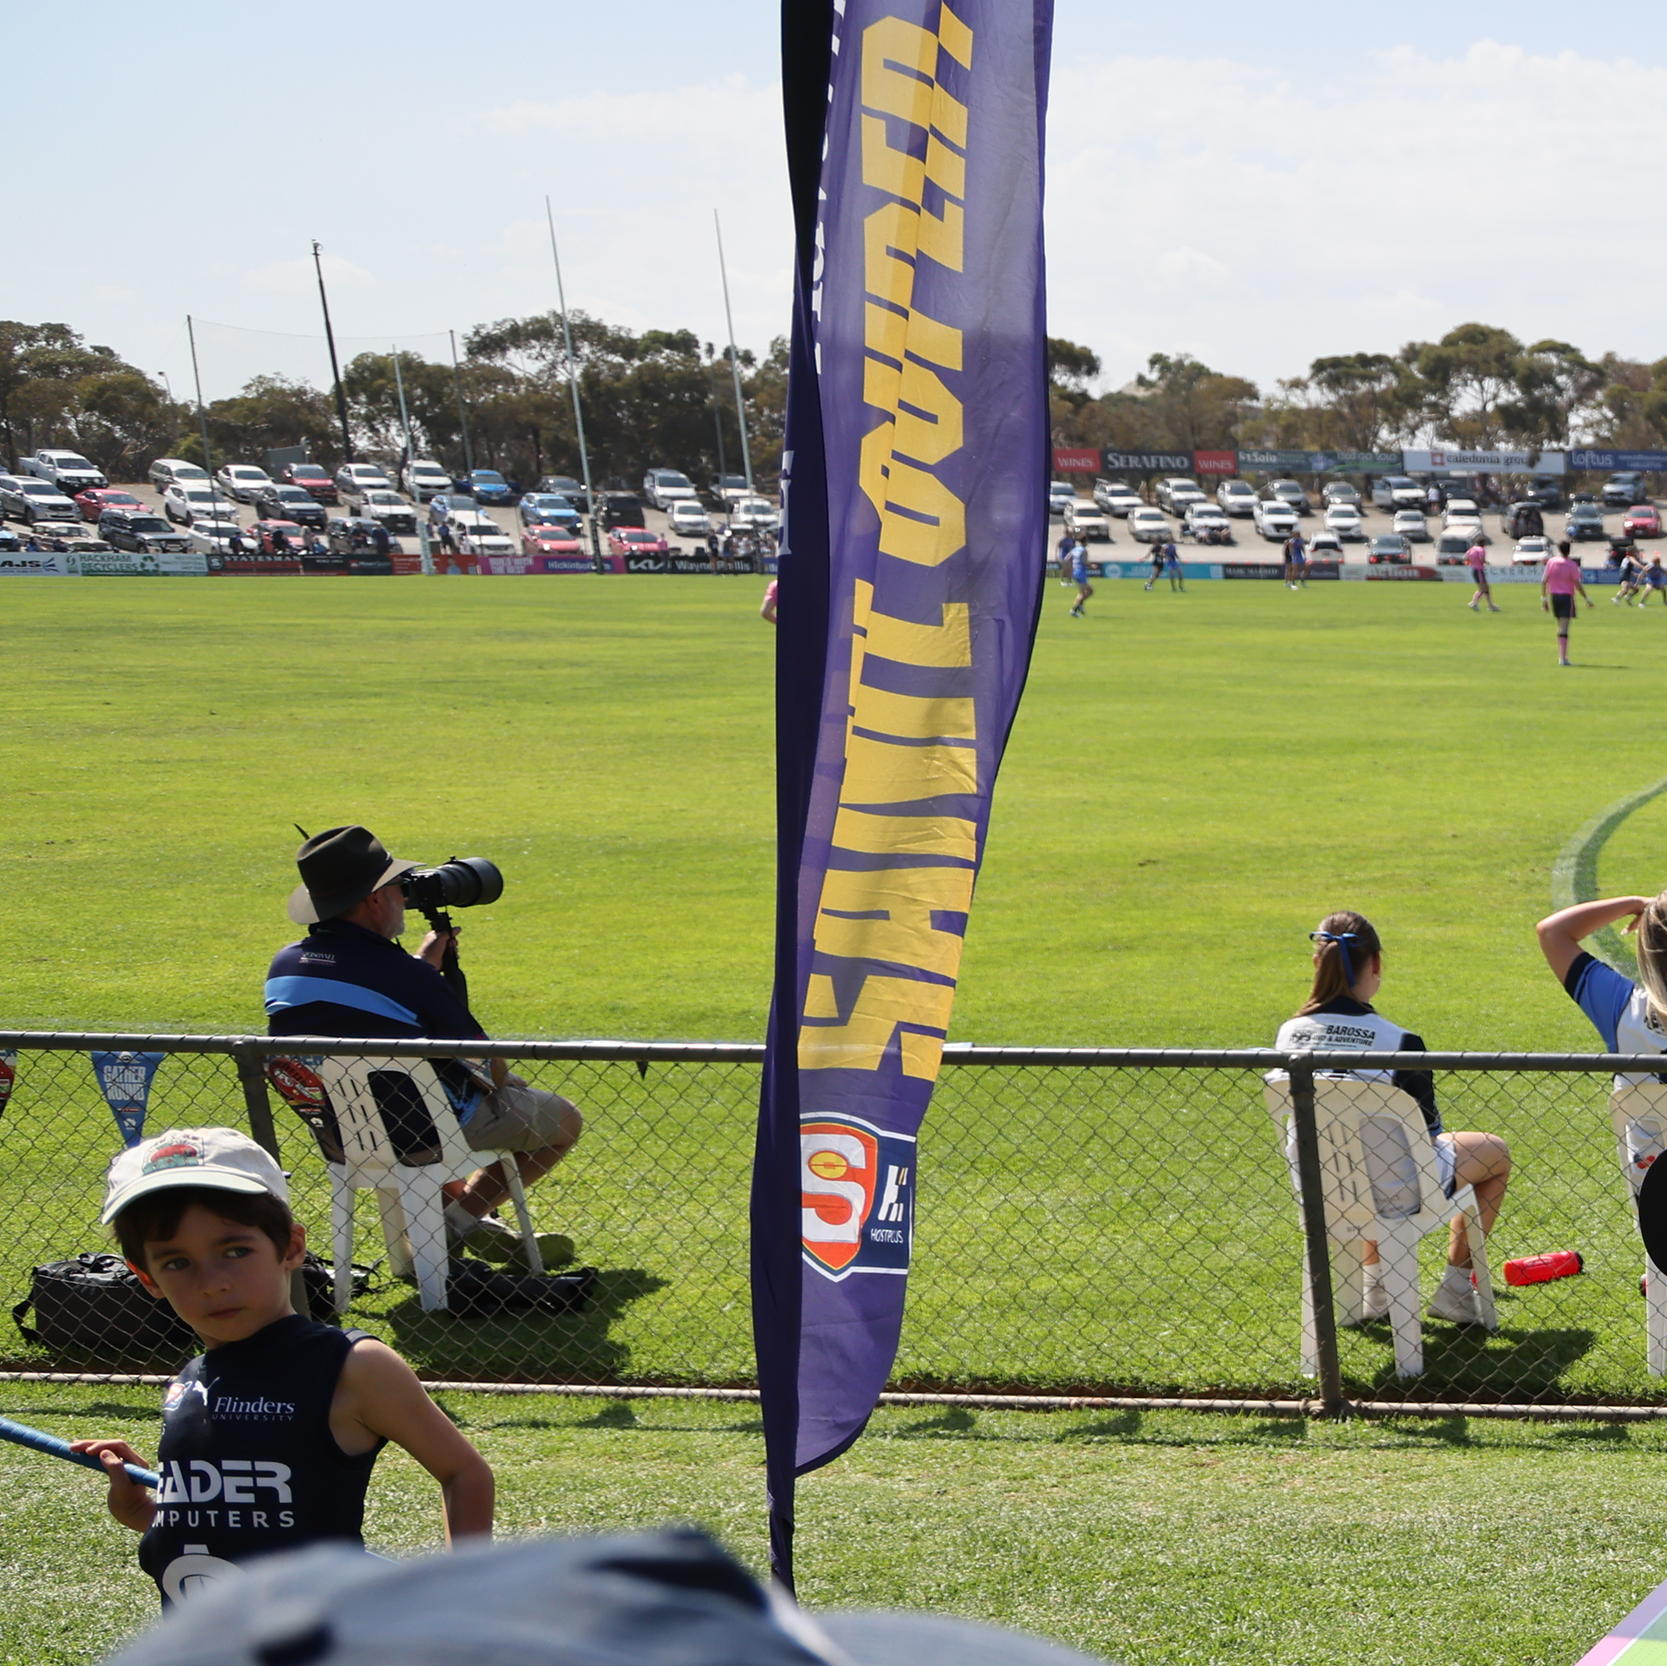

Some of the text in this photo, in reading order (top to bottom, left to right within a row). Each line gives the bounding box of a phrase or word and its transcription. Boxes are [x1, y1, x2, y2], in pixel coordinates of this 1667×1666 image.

[1057, 456, 1093, 467] WINES
[1107, 453, 1188, 468] SERAFINO
[1197, 458, 1233, 469] WINES
[1446, 453, 1499, 465] caledonia
[1571, 450, 1613, 468] loftus
[1326, 1025, 1376, 1041] BAROSSA
[1335, 1035, 1374, 1047] ADVENTURE
[104, 1065, 146, 1082] GATHER
[870, 1227, 904, 1245] HOSTPLUS
[214, 1396, 295, 1415] Flinders
[212, 1413, 294, 1423] UNIVERSITY
[156, 1459, 293, 1504] ADER
[152, 1510, 295, 1529] MPUTERS
